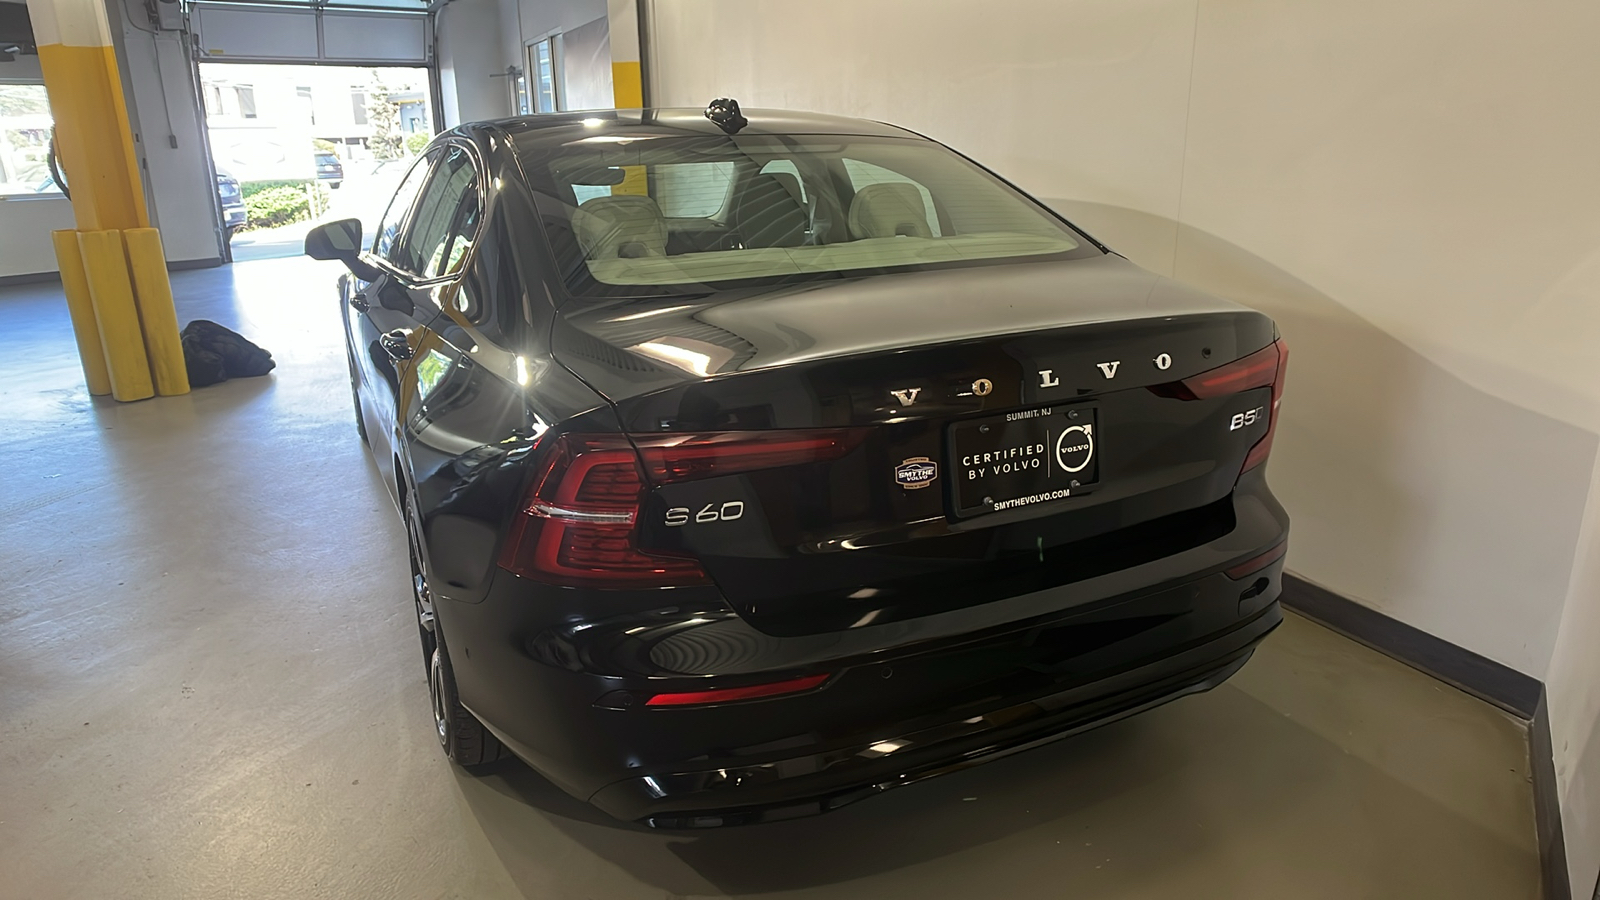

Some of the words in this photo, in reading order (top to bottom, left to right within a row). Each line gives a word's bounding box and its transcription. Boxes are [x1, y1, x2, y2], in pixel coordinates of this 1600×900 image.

[890, 352, 1173, 407] VOLVO
[1041, 407, 1052, 416] NJ
[962, 443, 1045, 467] CERTIFIED
[1060, 443, 1090, 454] VOLVO
[898, 469, 935, 479] SMYTHE
[968, 467, 986, 480] BY
[993, 458, 1040, 475] VOLVO
[994, 488, 1070, 511] SMYTHEVOLVO.COM
[664, 501, 744, 527] S60
